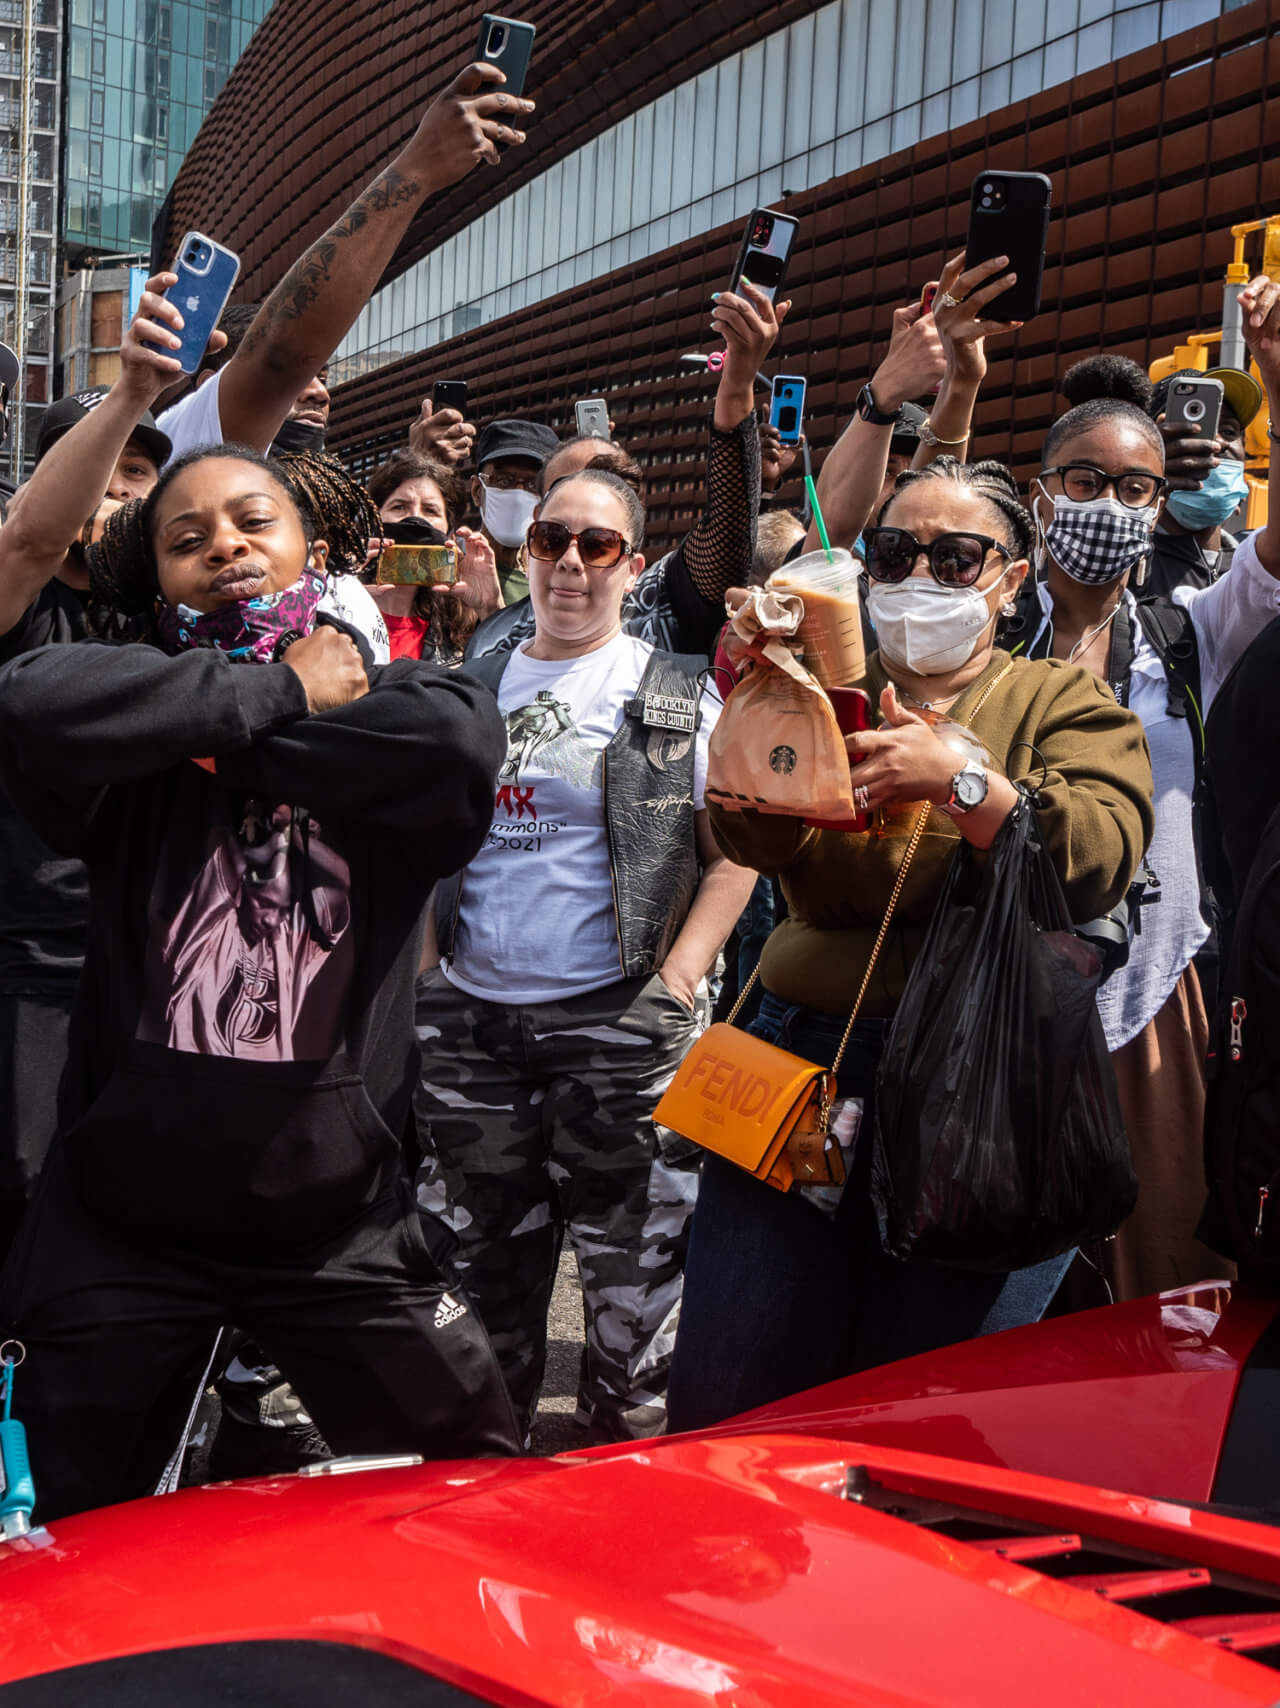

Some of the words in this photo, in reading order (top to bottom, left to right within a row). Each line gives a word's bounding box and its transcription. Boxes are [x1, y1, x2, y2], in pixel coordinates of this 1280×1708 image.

[646, 694, 695, 715] BROOKLYN
[1114, 682, 1123, 705] ONY
[645, 710, 666, 724] KINGS
[666, 712, 693, 729] COUNTY
[495, 784, 537, 821] MX
[489, 821, 567, 834] mmons"
[683, 1053, 781, 1126] FENDI
[434, 1305, 467, 1328] adidas
